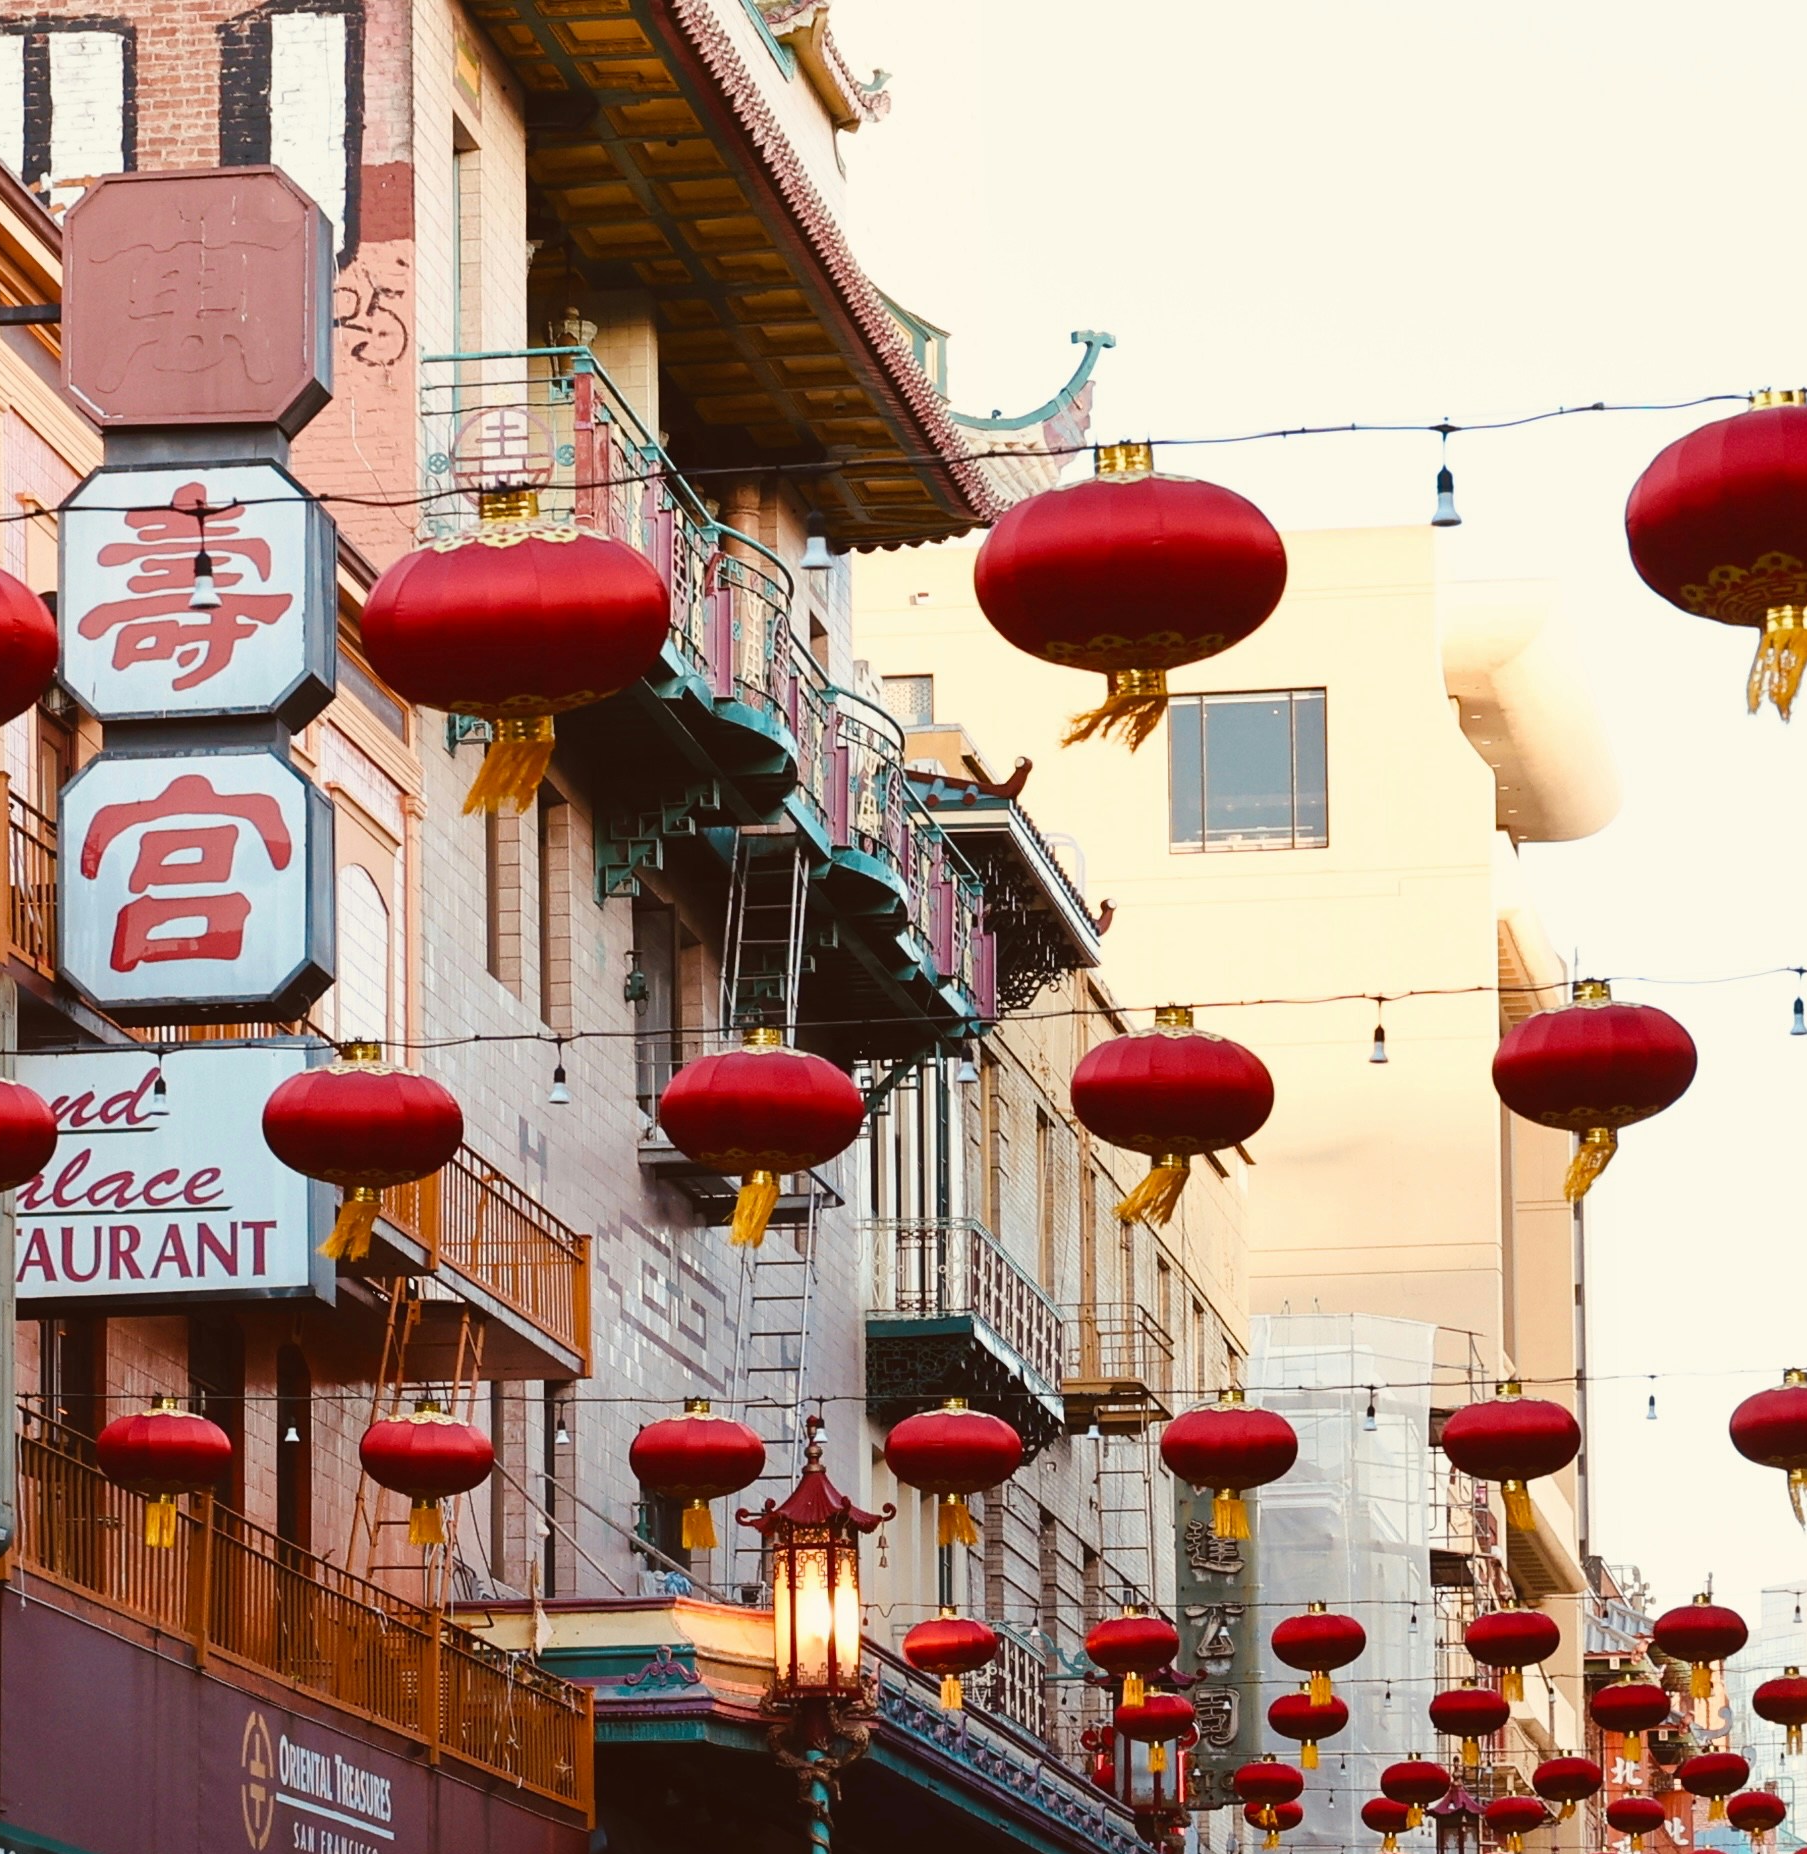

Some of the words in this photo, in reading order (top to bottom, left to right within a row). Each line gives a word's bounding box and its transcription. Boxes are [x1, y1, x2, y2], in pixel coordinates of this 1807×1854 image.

[18, 1148, 225, 1209] alace
[17, 1219, 279, 1283] AURANT
[279, 1734, 333, 1802] ORIENTAL
[335, 1753, 392, 1823] TREASURES
[293, 1820, 315, 1854] SAN
